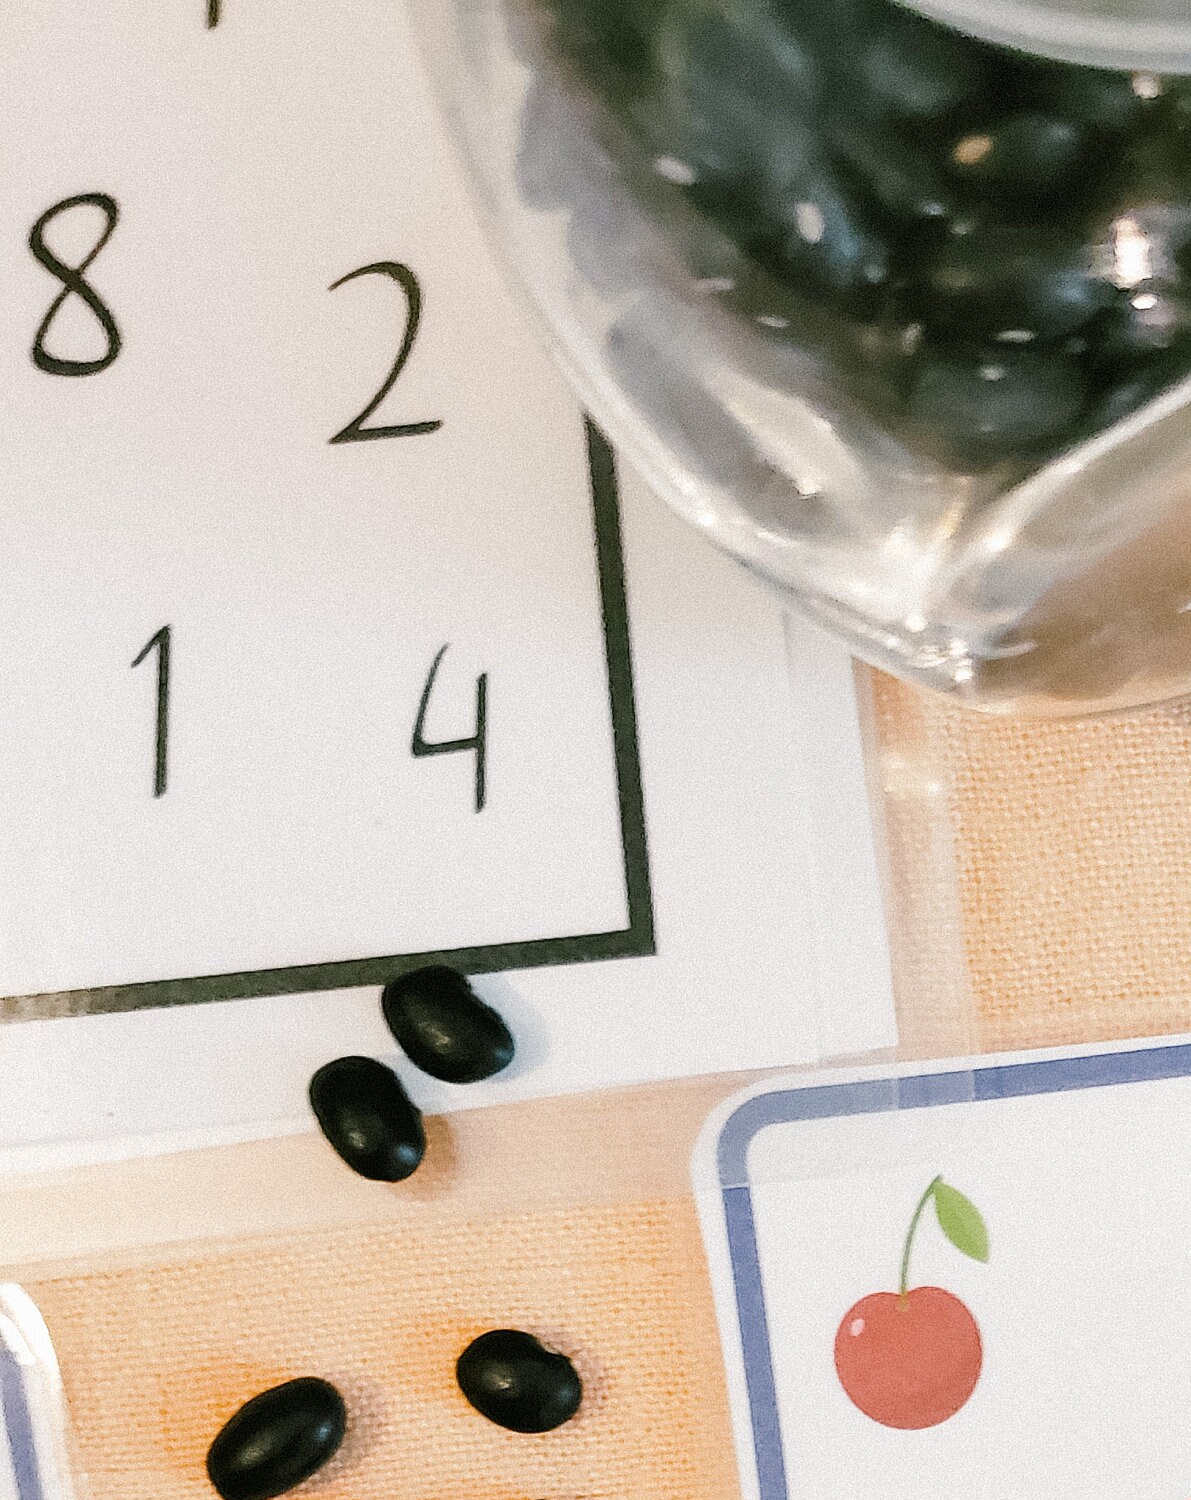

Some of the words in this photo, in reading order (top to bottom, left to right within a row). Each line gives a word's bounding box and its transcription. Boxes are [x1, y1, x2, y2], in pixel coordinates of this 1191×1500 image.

[27, 191, 123, 377] 8
[328, 260, 443, 446] 2
[131, 624, 172, 799] 1
[411, 642, 488, 814] 4
